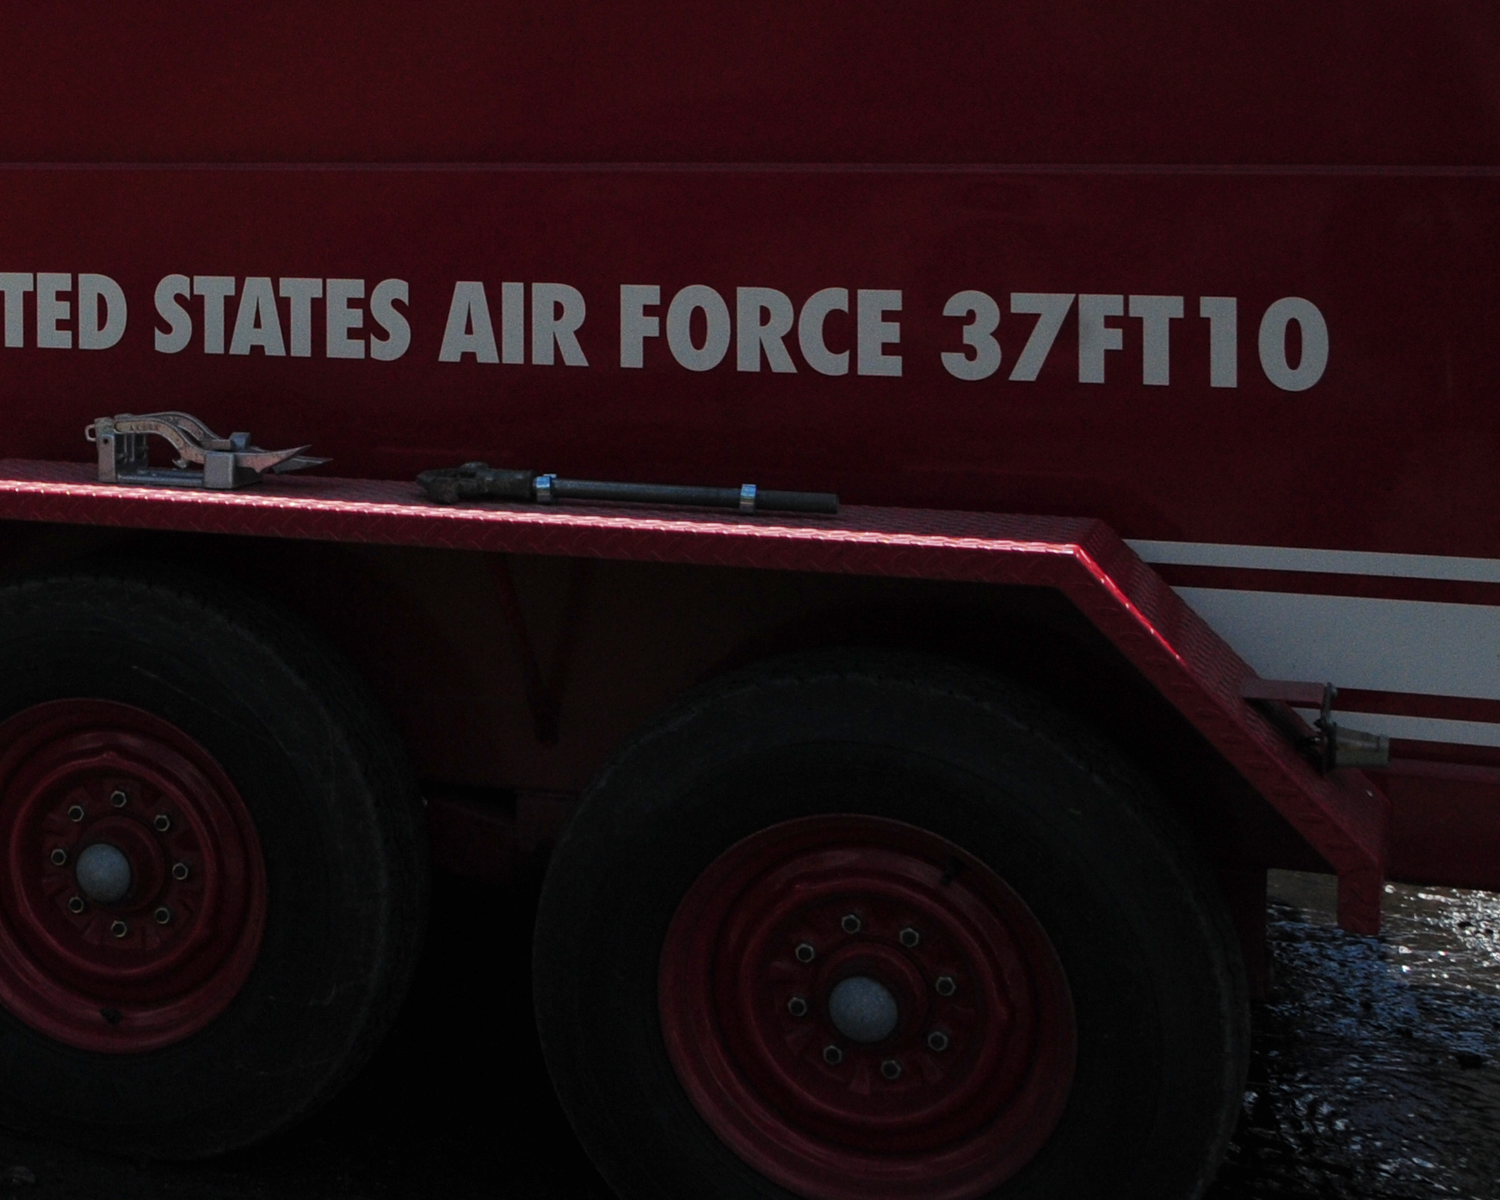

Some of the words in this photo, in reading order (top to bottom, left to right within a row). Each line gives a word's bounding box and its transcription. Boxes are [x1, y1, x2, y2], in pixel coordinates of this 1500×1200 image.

[153, 273, 411, 361] STATES
[438, 280, 590, 367] AIR
[620, 284, 903, 377] FORCE
[940, 289, 1329, 392] 37FT10
